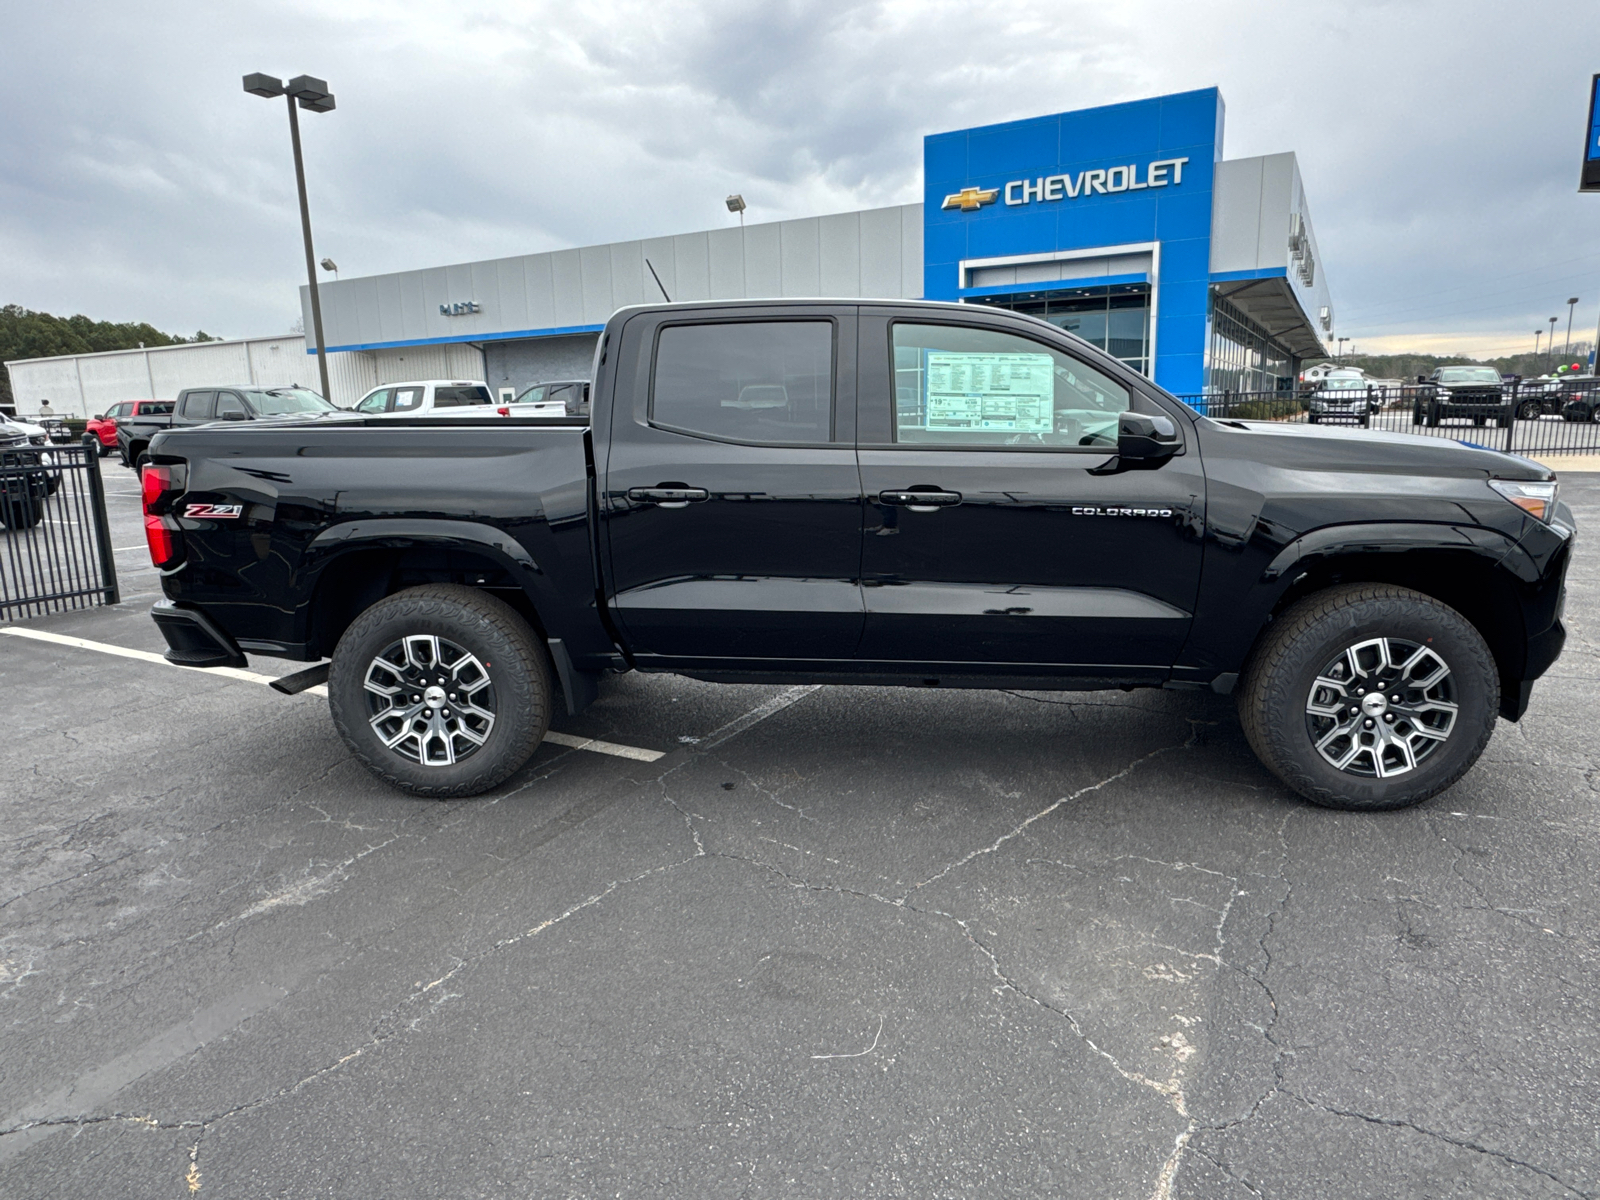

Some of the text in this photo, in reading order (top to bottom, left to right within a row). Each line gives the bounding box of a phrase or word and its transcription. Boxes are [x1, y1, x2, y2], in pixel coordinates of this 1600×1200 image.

[1004, 157, 1189, 206] CHEVROLET
[184, 504, 243, 519] Z71
[1072, 507, 1172, 518] COLORADO
